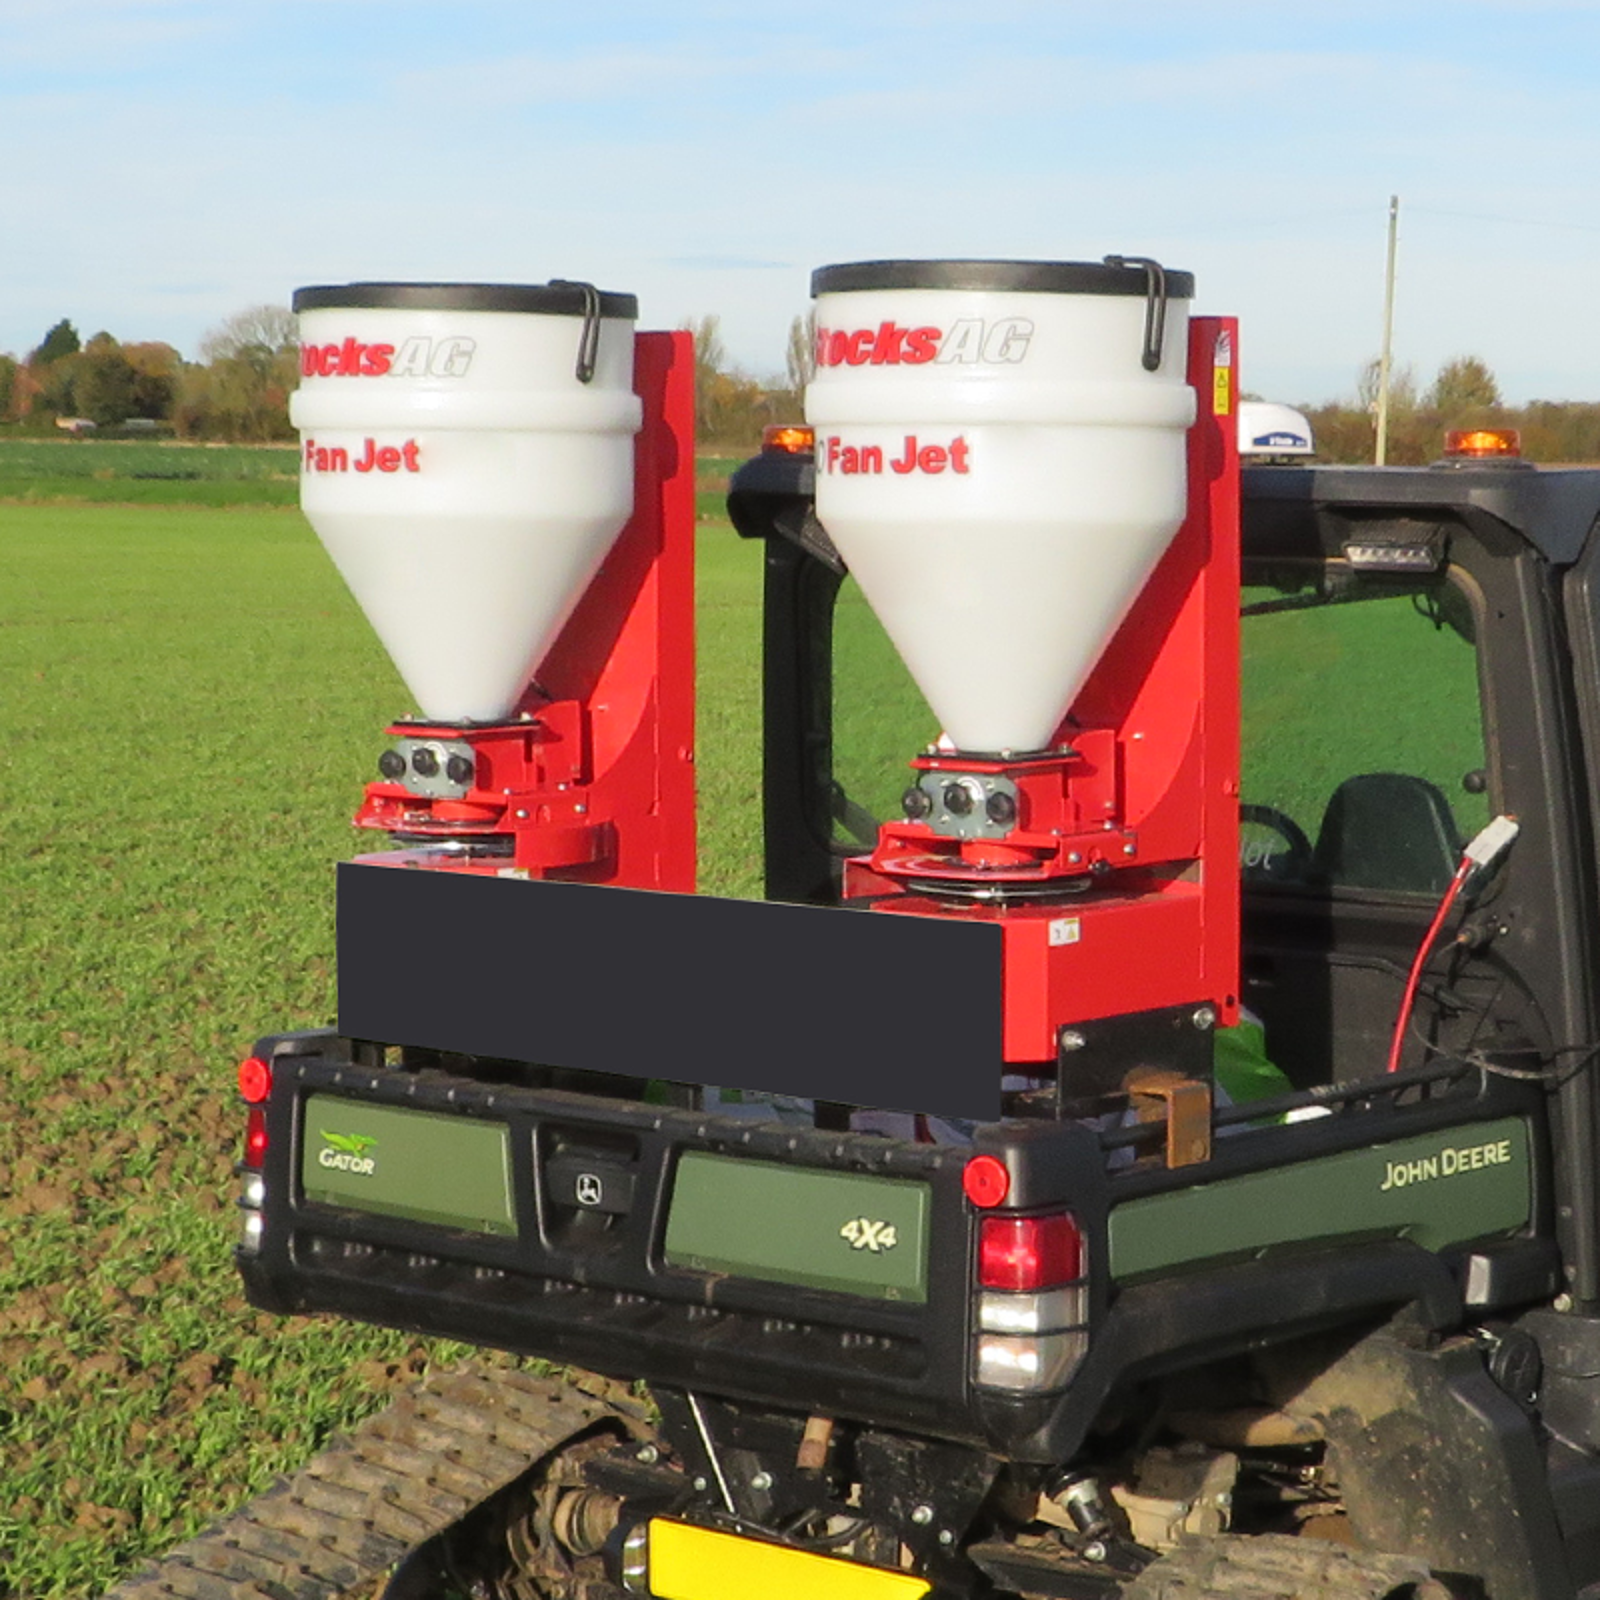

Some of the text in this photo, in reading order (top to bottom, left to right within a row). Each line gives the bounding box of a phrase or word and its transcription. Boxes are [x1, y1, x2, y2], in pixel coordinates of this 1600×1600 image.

[301, 337, 476, 378] ocksAG
[305, 437, 421, 473] Fan Jet
[827, 436, 883, 475] Fan
[890, 435, 970, 475] Jet
[318, 1148, 375, 1176] GATOR
[1380, 1140, 1511, 1191] JOHN DEERE
